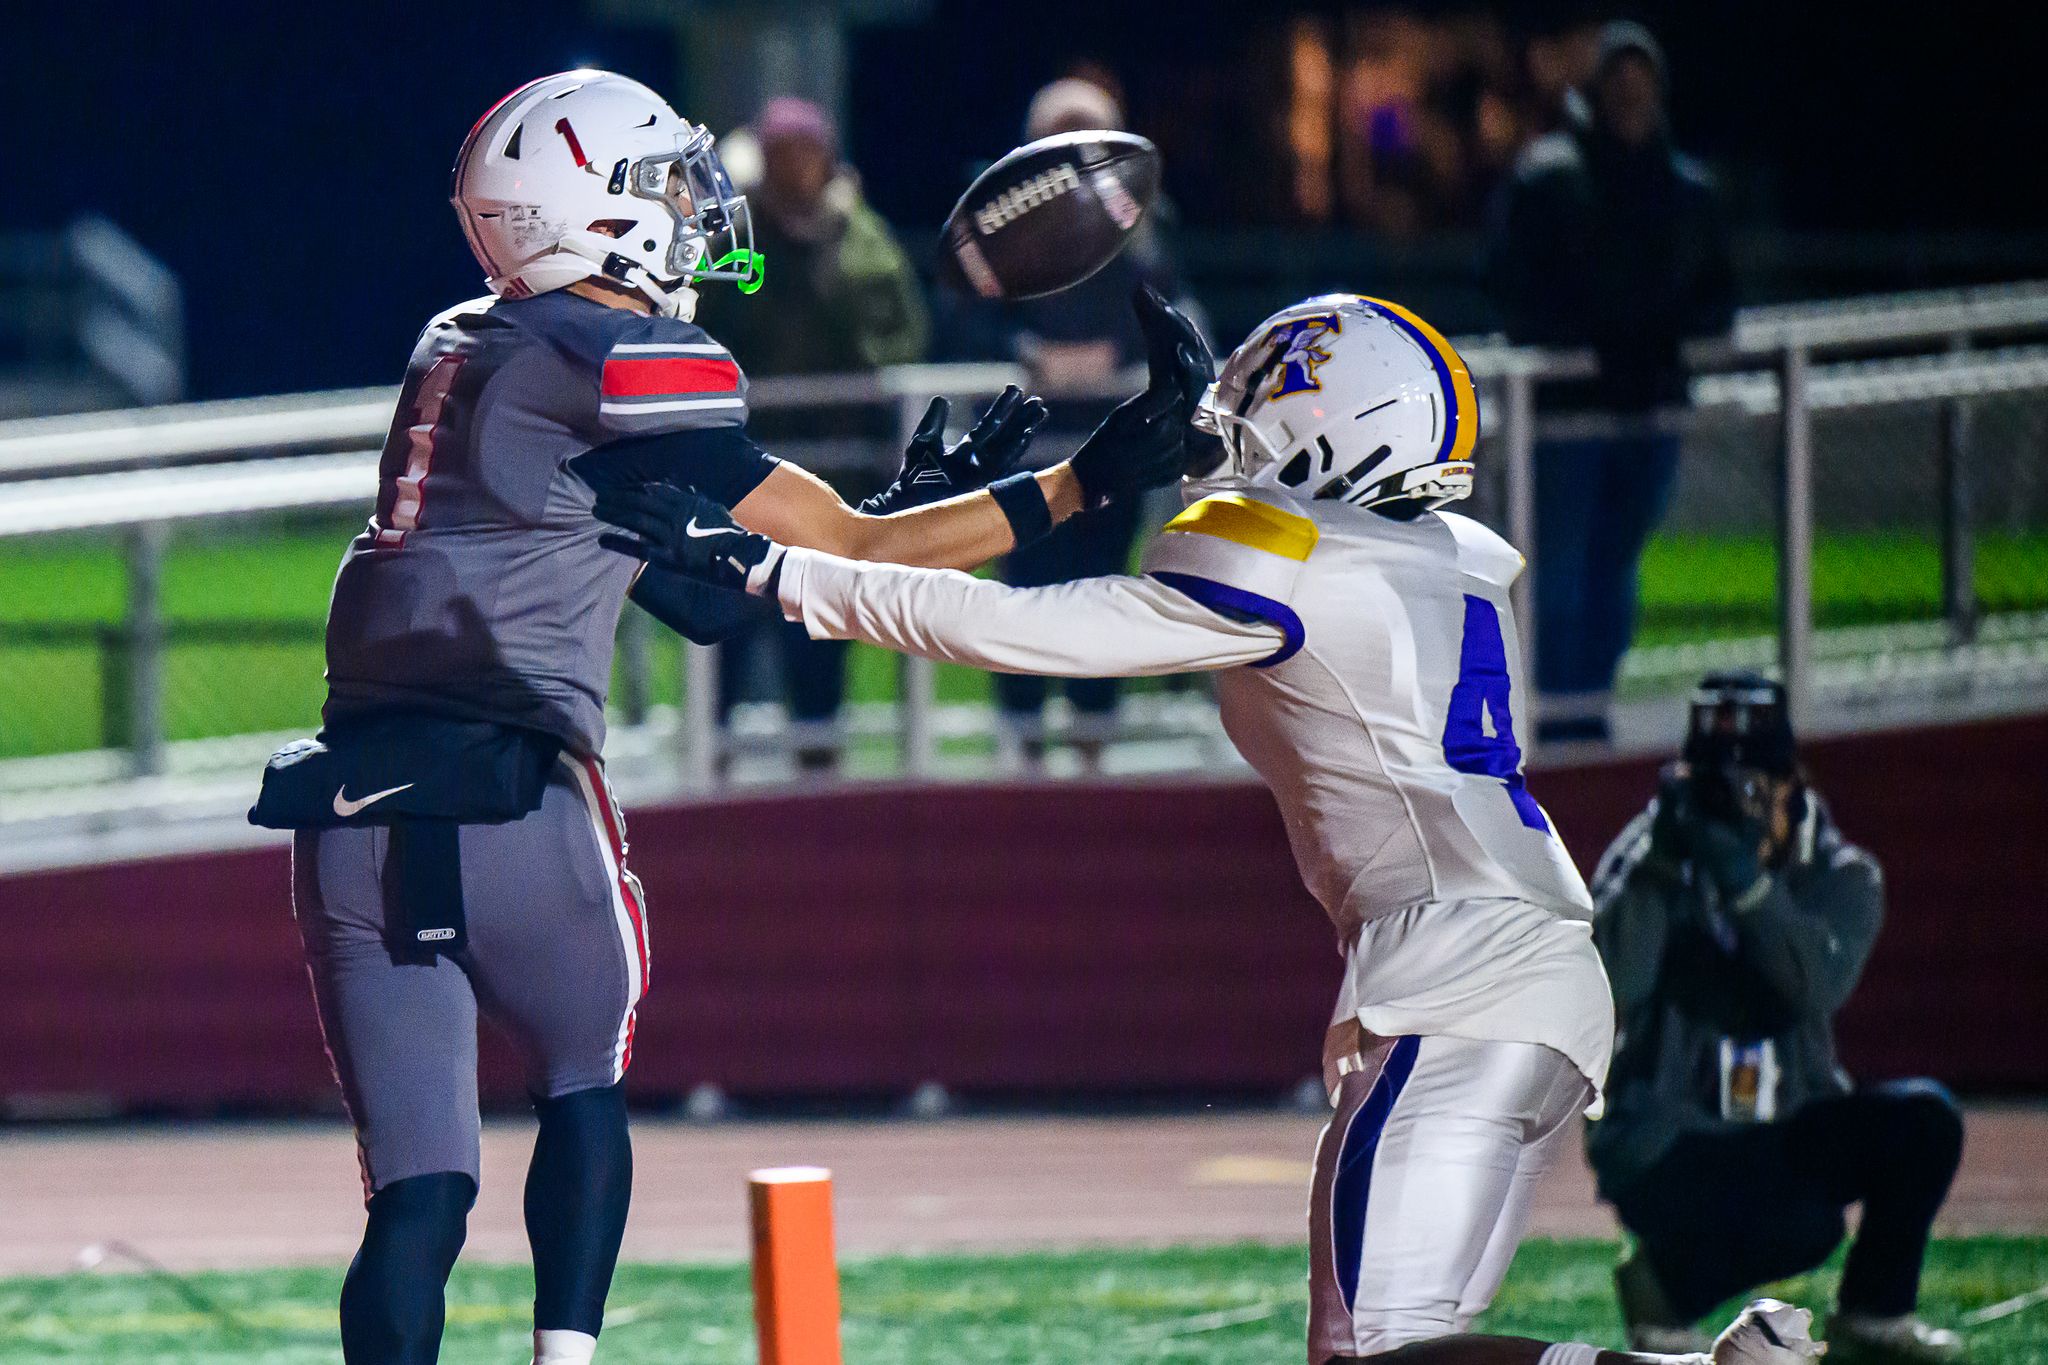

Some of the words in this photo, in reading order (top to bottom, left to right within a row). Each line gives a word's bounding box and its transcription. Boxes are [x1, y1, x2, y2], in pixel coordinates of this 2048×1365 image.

[555, 117, 587, 168] 1
[375, 353, 467, 550] 1
[1441, 592, 1553, 837] 4
